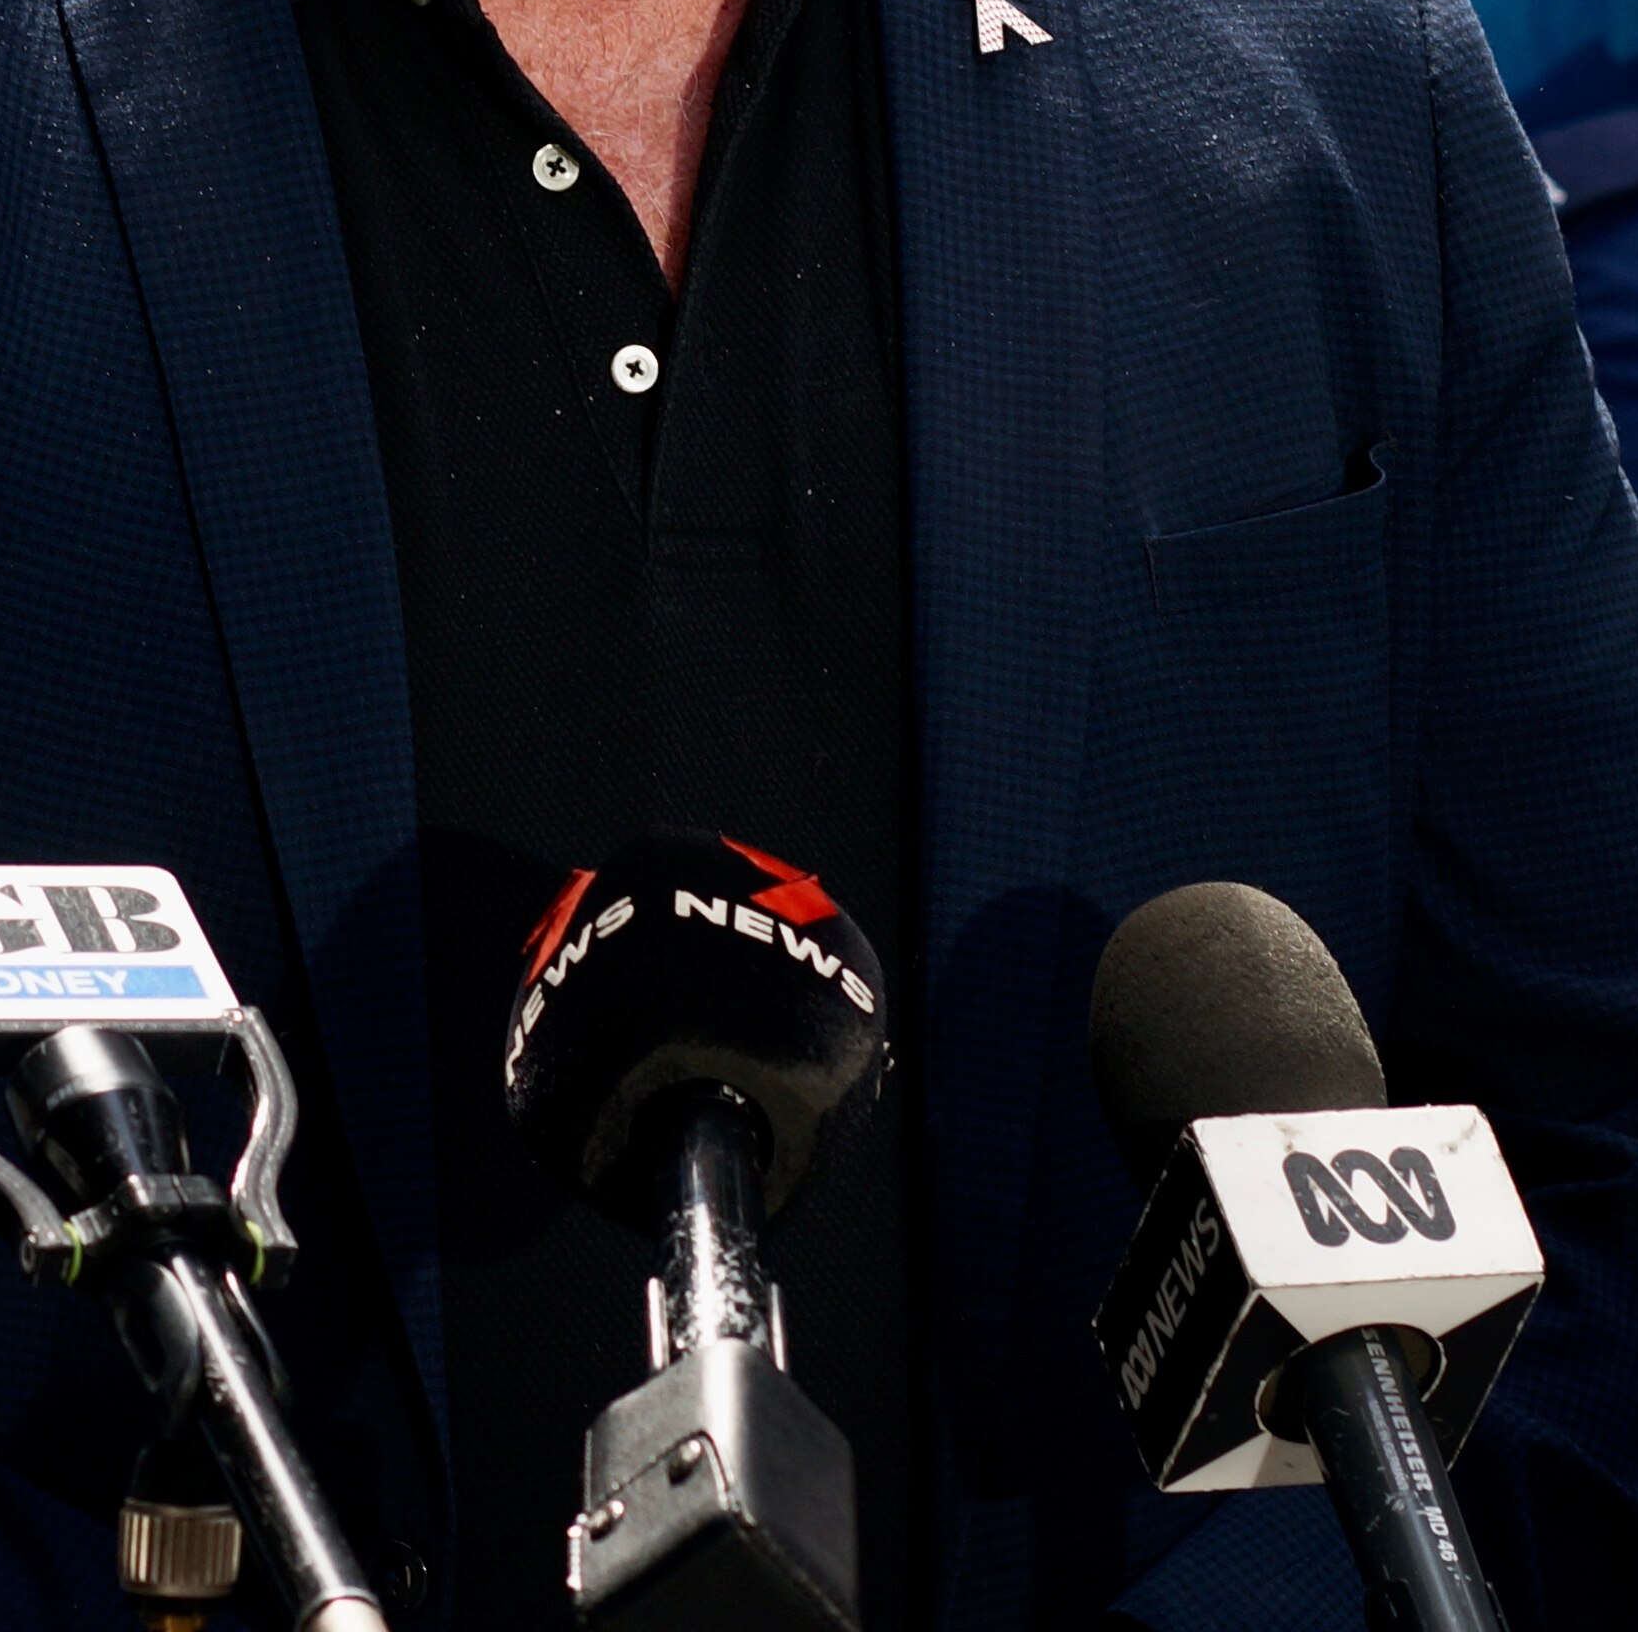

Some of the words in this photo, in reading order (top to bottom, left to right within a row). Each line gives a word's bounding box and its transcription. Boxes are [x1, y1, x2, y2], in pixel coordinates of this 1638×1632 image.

[674, 888, 876, 1015] NEWS
[1145, 1196, 1221, 1359] NEWS
[1359, 1325, 1434, 1492] SENNHEISER
[1423, 1504, 1449, 1533] MD
[1436, 1538, 1459, 1565] 46
